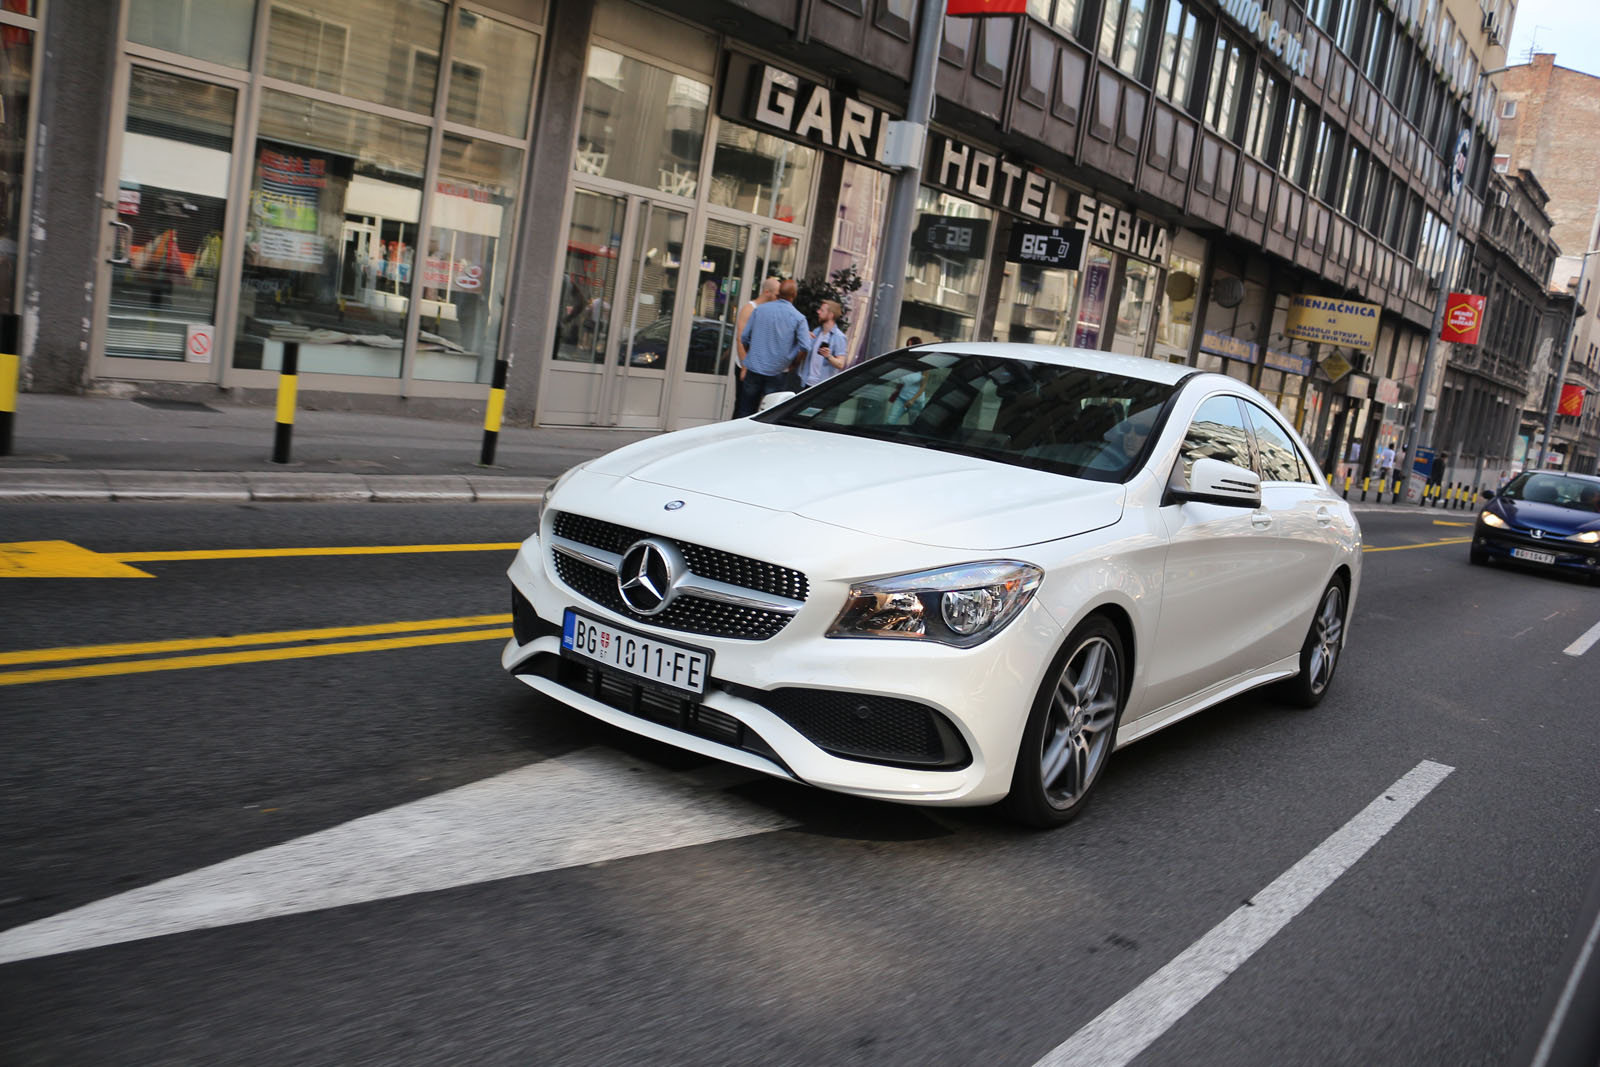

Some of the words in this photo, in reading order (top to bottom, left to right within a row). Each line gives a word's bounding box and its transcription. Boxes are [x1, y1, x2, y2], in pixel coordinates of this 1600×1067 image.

[939, 138, 1060, 225] HOTEL
[1074, 194, 1168, 264] SRBIJA
[1021, 234, 1049, 256] BG
[1293, 297, 1376, 318] MENJAČNICA
[575, 620, 598, 654] BG
